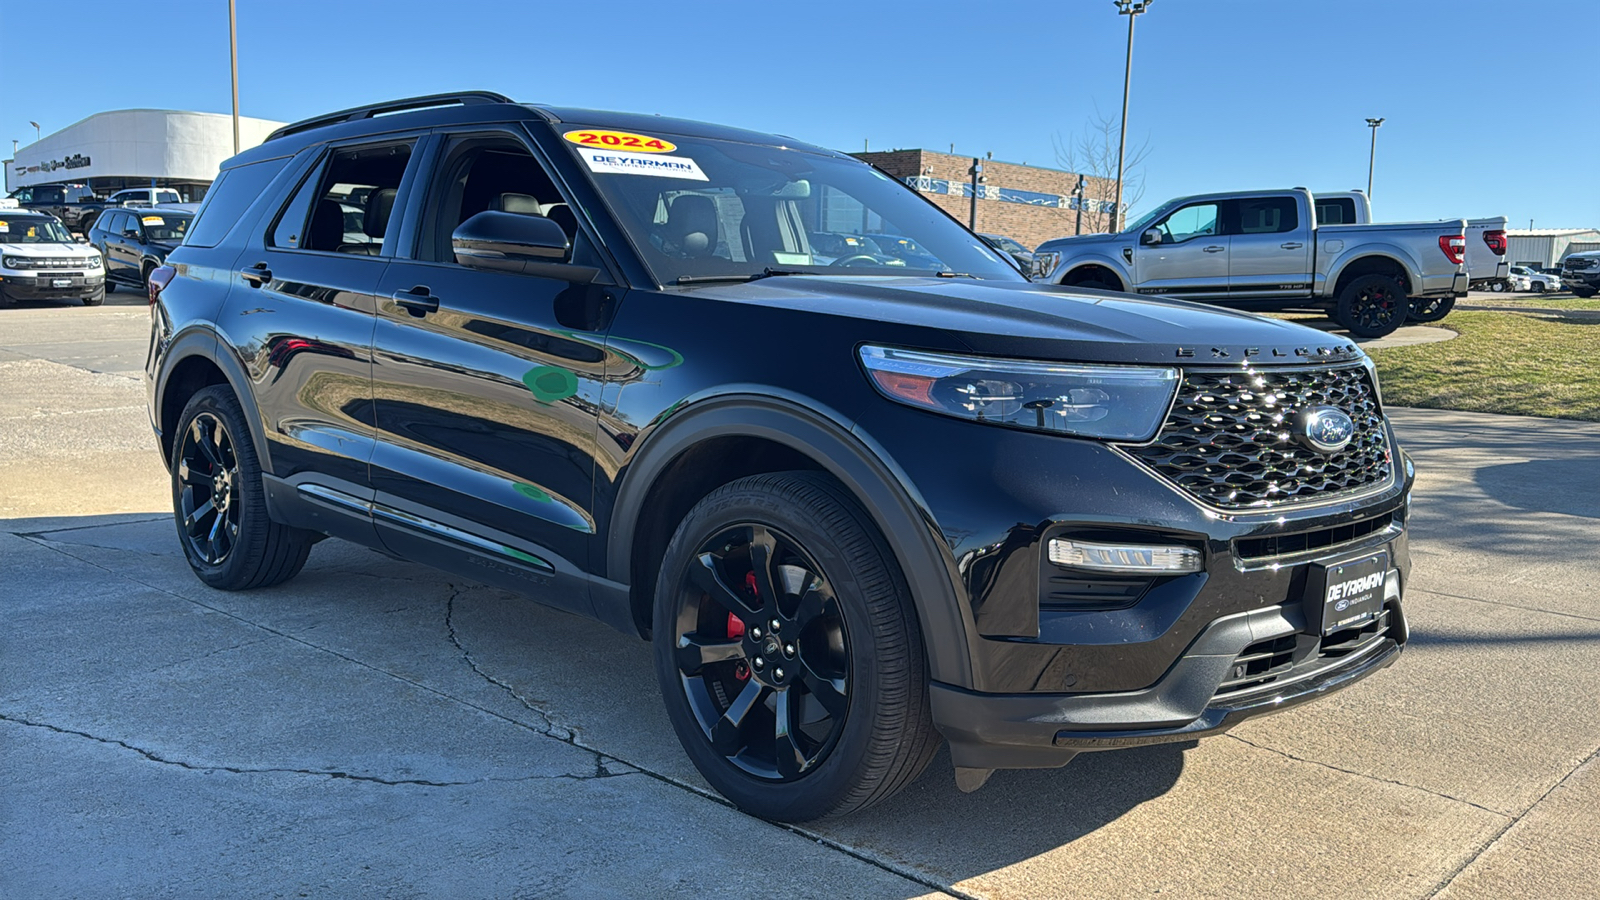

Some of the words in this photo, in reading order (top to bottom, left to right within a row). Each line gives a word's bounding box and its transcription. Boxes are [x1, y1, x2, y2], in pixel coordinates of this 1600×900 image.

[578, 133, 667, 151] 2024
[592, 155, 692, 170] DEYARMAN
[1326, 571, 1385, 603] DEYARMAN
